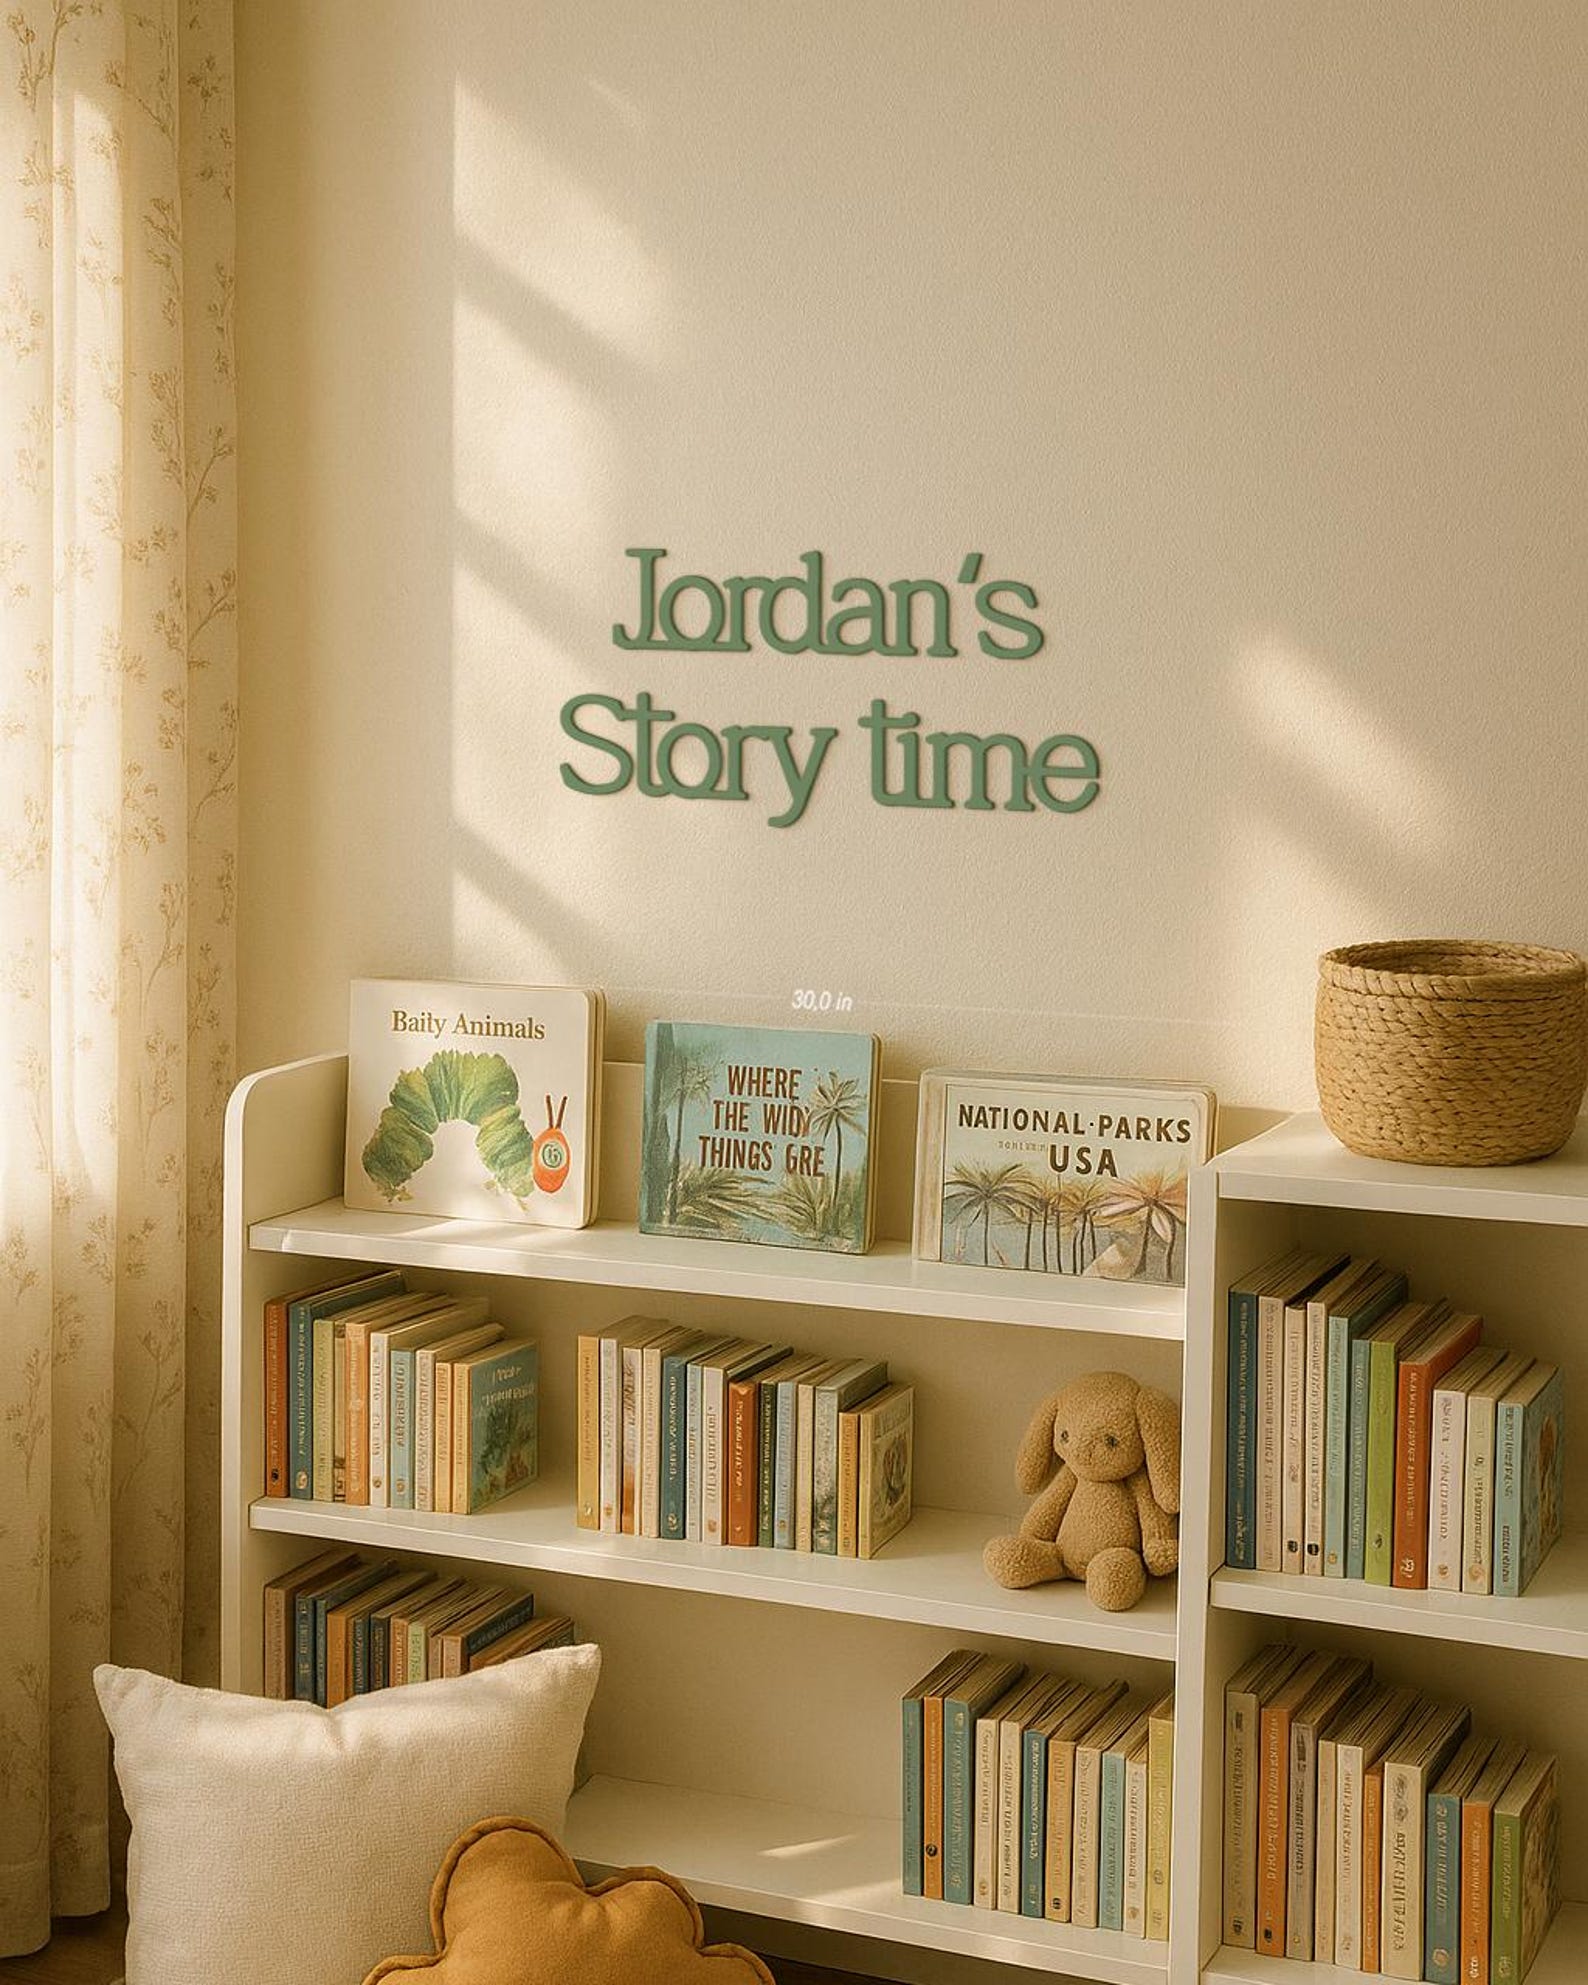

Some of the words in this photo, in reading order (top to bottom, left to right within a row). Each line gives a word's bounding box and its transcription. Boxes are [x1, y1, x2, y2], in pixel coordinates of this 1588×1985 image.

[612, 548, 1045, 659] Jordan's
[560, 691, 838, 828] Story
[858, 699, 1100, 813] time
[452, 1013, 545, 1040] Animals
[728, 1065, 802, 1100] WHERE
[713, 1100, 750, 1132] THE
[699, 1135, 772, 1171] THINGS
[1050, 1144, 1118, 1178] USA
